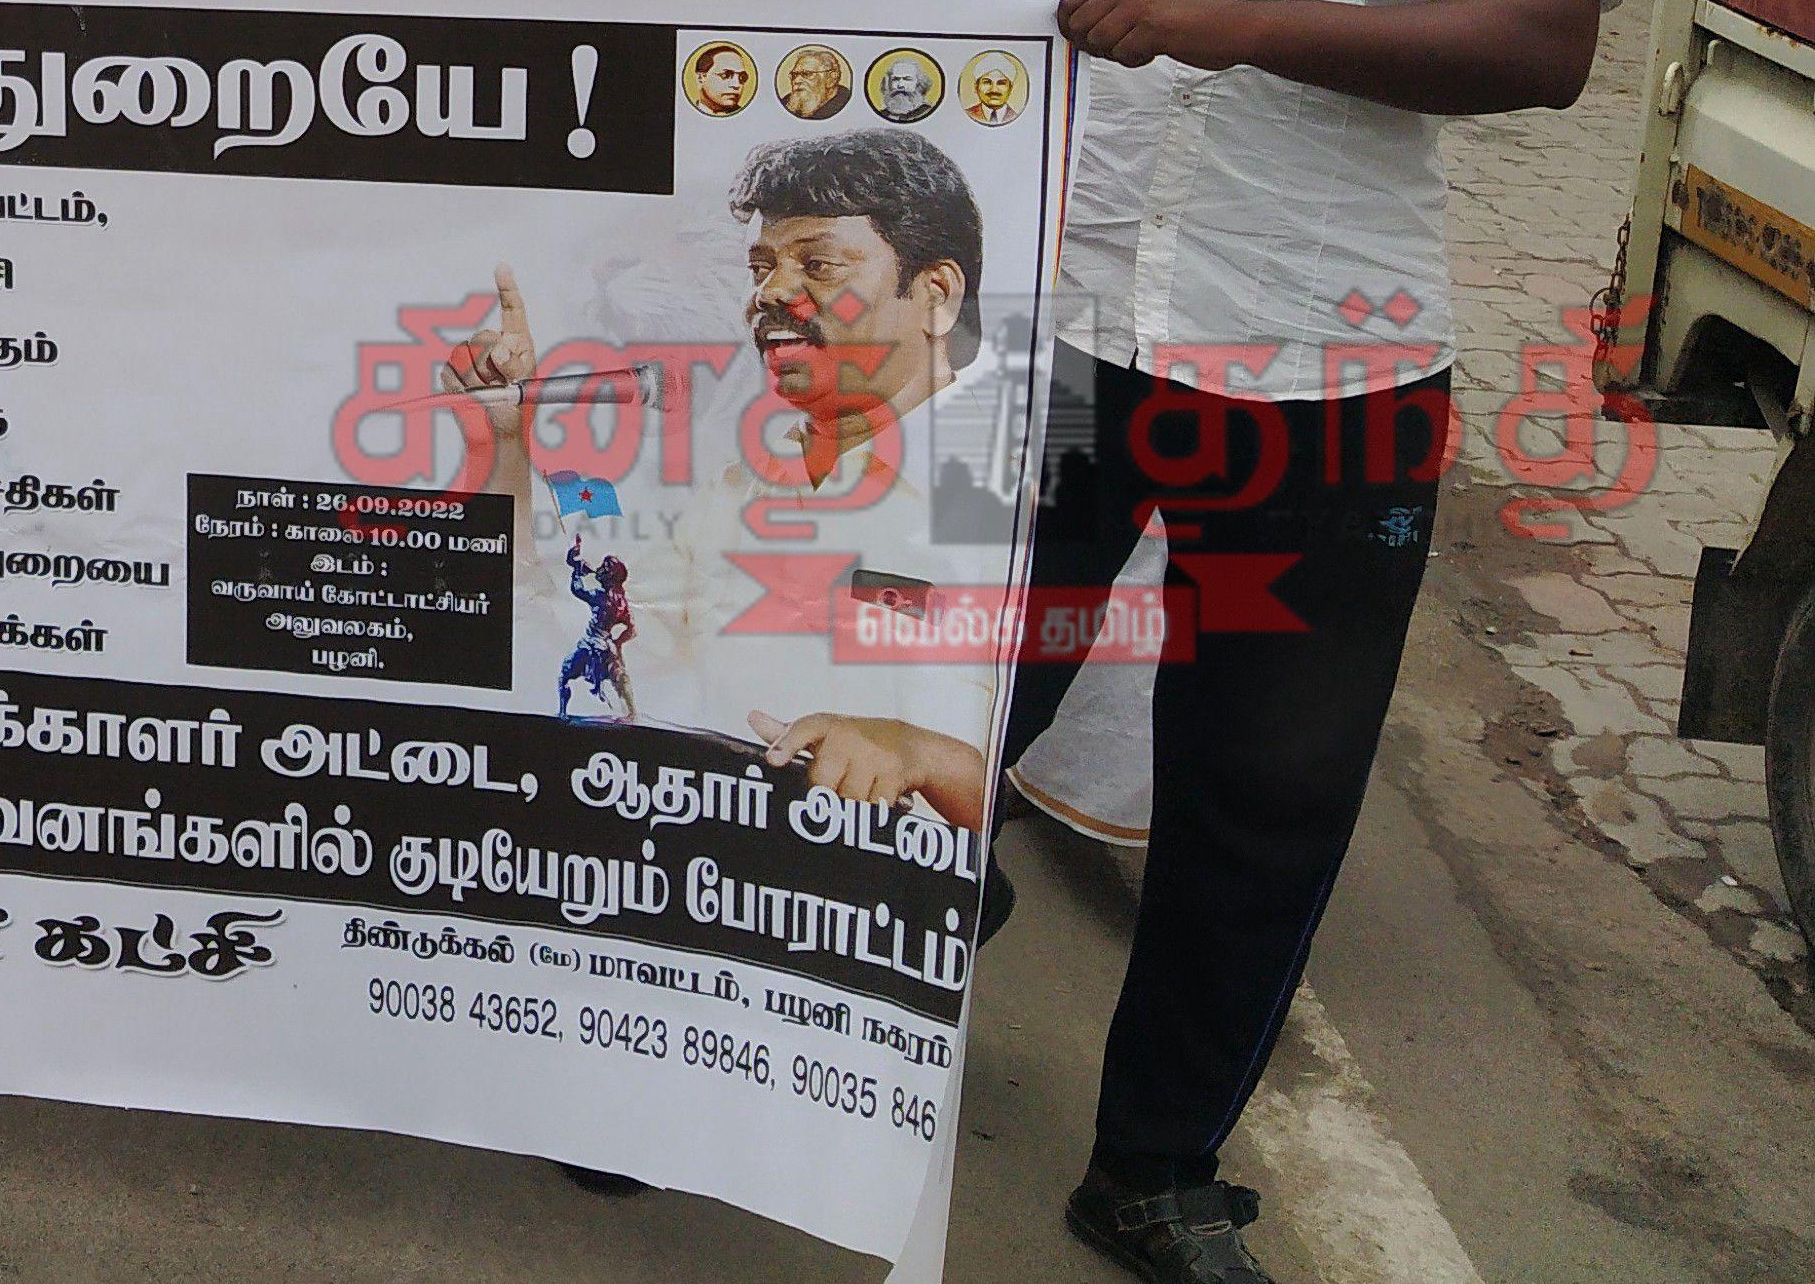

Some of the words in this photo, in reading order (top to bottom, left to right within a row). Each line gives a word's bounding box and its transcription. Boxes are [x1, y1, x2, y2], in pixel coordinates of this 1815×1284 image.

[236, 487, 295, 509] நாள்
[316, 494, 465, 520] 26.09.2022
[195, 514, 264, 539] நேரம்
[285, 527, 364, 544] காலை
[370, 528, 440, 549] 10.00
[449, 534, 508, 555] மணி
[311, 554, 374, 576] இடம்
[211, 580, 314, 601] வருவாய்
[322, 584, 490, 614] கோட்டாட்சியர்
[266, 613, 413, 642] அலுவலகம்,
[312, 647, 384, 671] பழனி.
[261, 724, 539, 803] அட்டை,
[571, 751, 774, 832] ஆதார்
[389, 828, 670, 925] குடியேறும்
[685, 856, 970, 994] போராட்டம்
[34, 908, 284, 978] கட்சி
[341, 918, 514, 964] திண்டுக்கல்
[588, 952, 751, 1009] மாவட்டம்,
[764, 986, 851, 1037] பழனி
[861, 1012, 953, 1070] நகரம்
[369, 977, 456, 1022] 90038
[469, 991, 564, 1042] 43652,
[579, 1005, 668, 1059] 90423
[683, 1027, 777, 1091] 89846,
[791, 1056, 878, 1118] 90035
